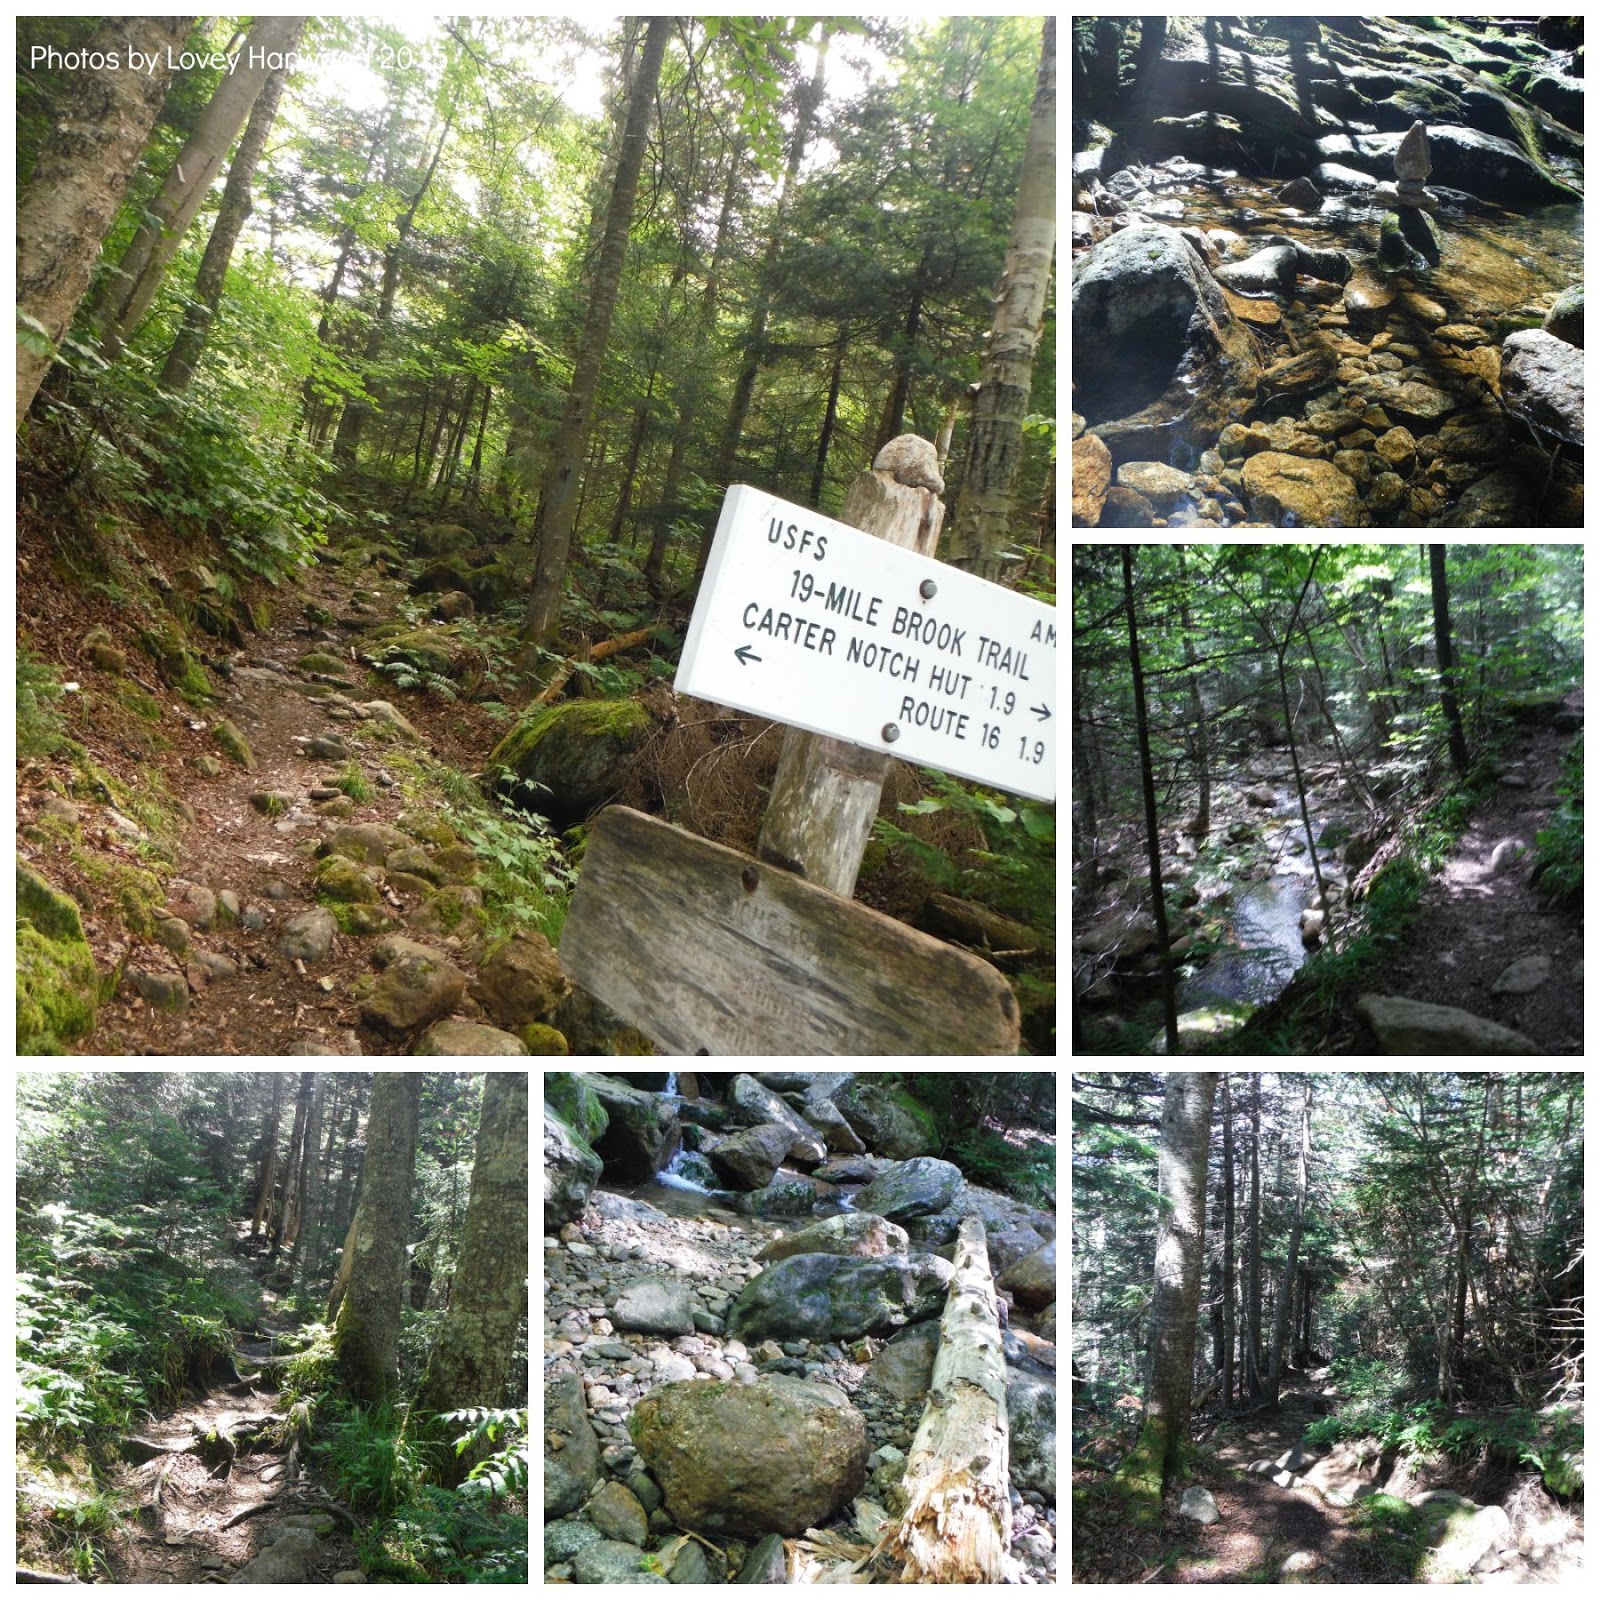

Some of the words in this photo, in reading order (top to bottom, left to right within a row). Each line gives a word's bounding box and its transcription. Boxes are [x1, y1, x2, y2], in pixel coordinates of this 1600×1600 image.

[768, 517, 828, 561] USFS
[742, 602, 836, 655] CARTER
[846, 636, 919, 683] NOTCH
[928, 665, 972, 700] HUT
[990, 685, 1016, 716] 1.9
[790, 569, 883, 627] 19-MILE
[891, 606, 967, 657] BROOK
[977, 636, 1030, 681] TRAIL
[899, 696, 970, 740] ROUTE
[981, 722, 1001, 750] 16
[1018, 735, 1045, 765] 1.9
